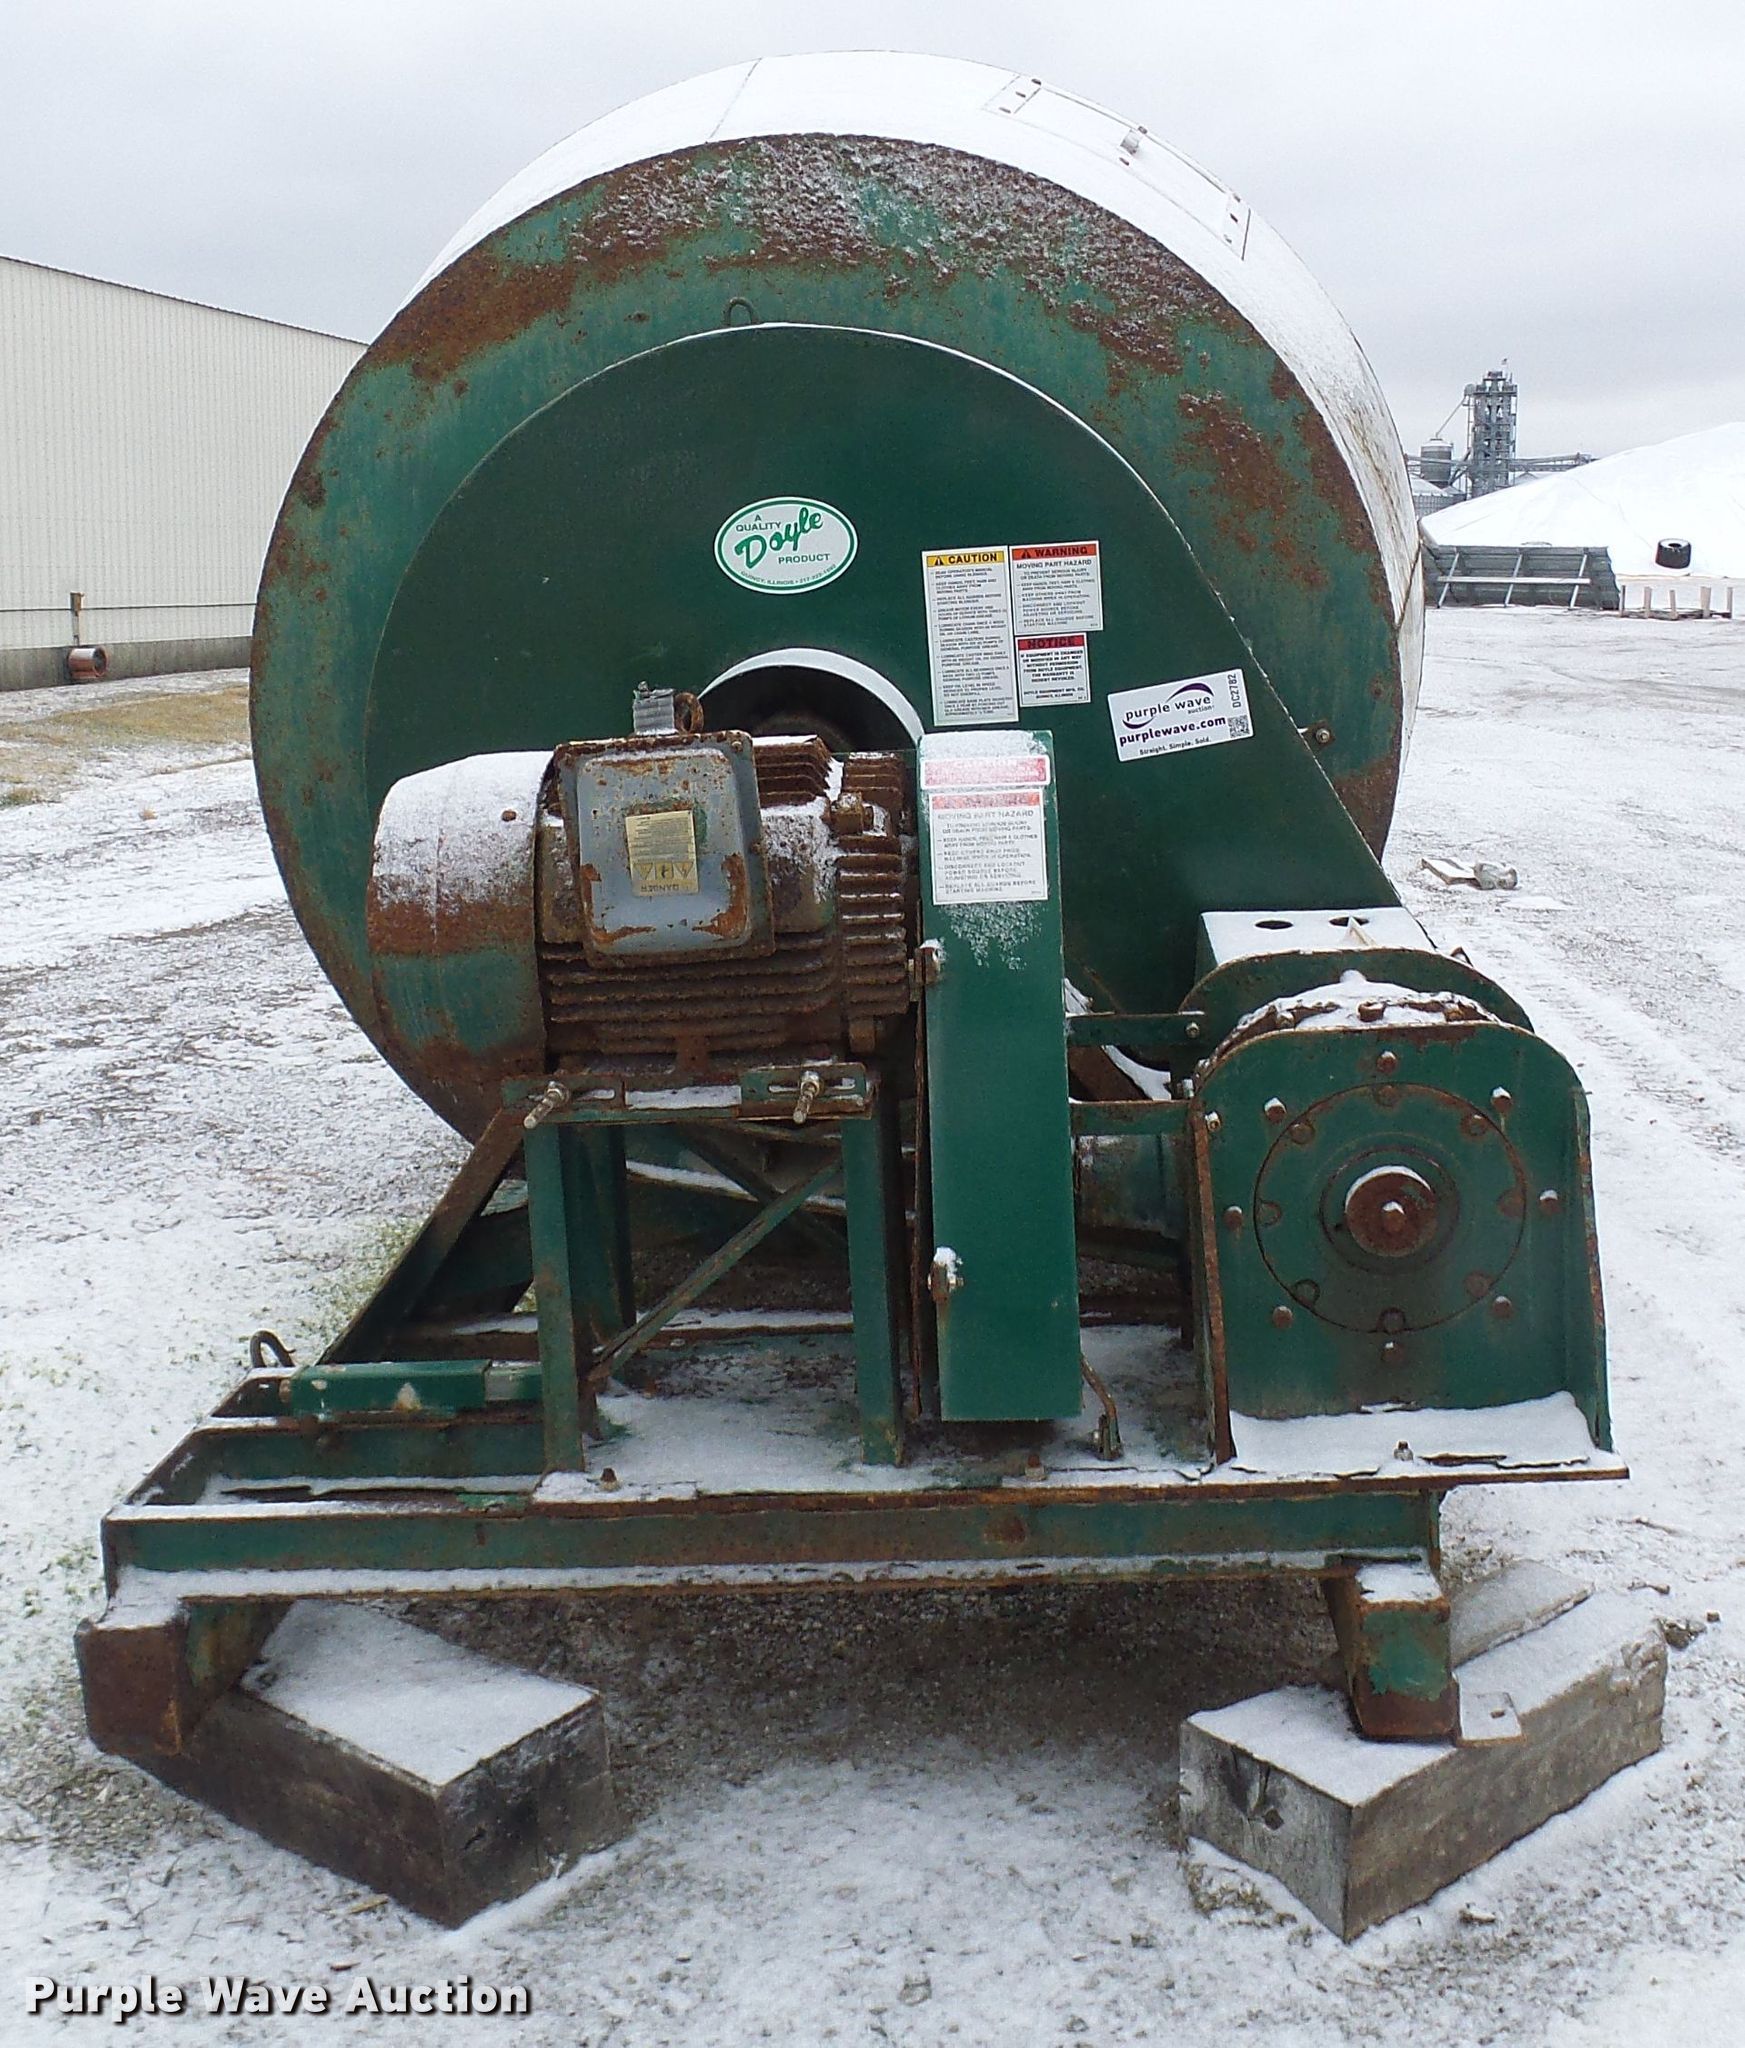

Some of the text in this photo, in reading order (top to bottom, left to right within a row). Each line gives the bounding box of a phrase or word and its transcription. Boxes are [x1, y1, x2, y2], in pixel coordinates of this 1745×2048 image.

[735, 521, 782, 532] QUALITY
[734, 507, 824, 569] Doyle
[1035, 547, 1088, 557] WARNING
[778, 554, 831, 564] PRODUCT
[948, 553, 997, 564] CAUTION
[1027, 637, 1075, 649] NOTICE
[1125, 696, 1211, 722] purple wave
[1187, 706, 1213, 714] auction
[1119, 717, 1226, 747] purplewave.com
[1139, 746, 1167, 755] Straight.
[1169, 741, 1194, 750] Simple.
